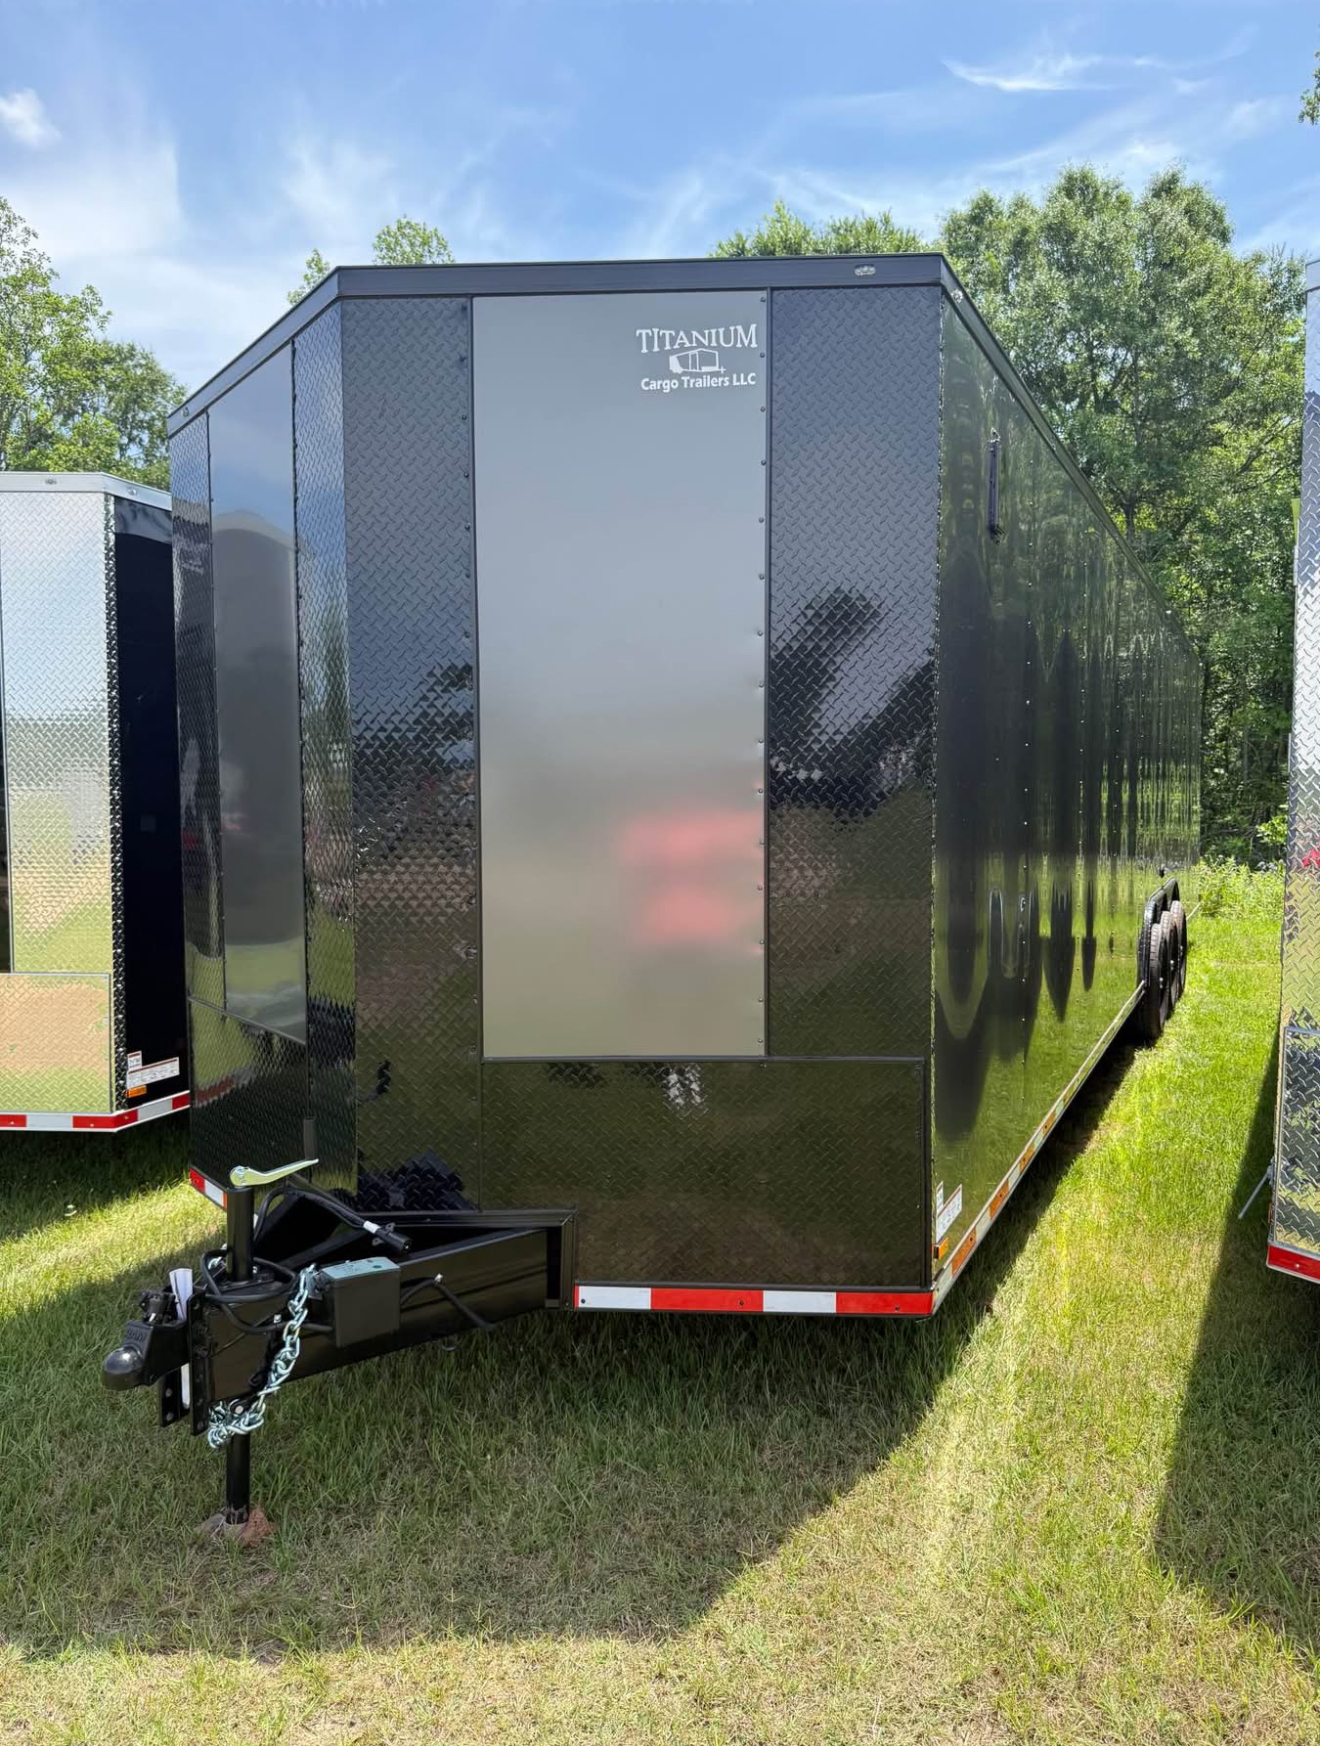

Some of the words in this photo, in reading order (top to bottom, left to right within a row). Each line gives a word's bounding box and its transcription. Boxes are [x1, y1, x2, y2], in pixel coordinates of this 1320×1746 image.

[636, 323, 758, 353] TITANIUM
[640, 378, 679, 393] Cargo
[681, 375, 730, 388] Trailers
[732, 372, 756, 386] LLC
